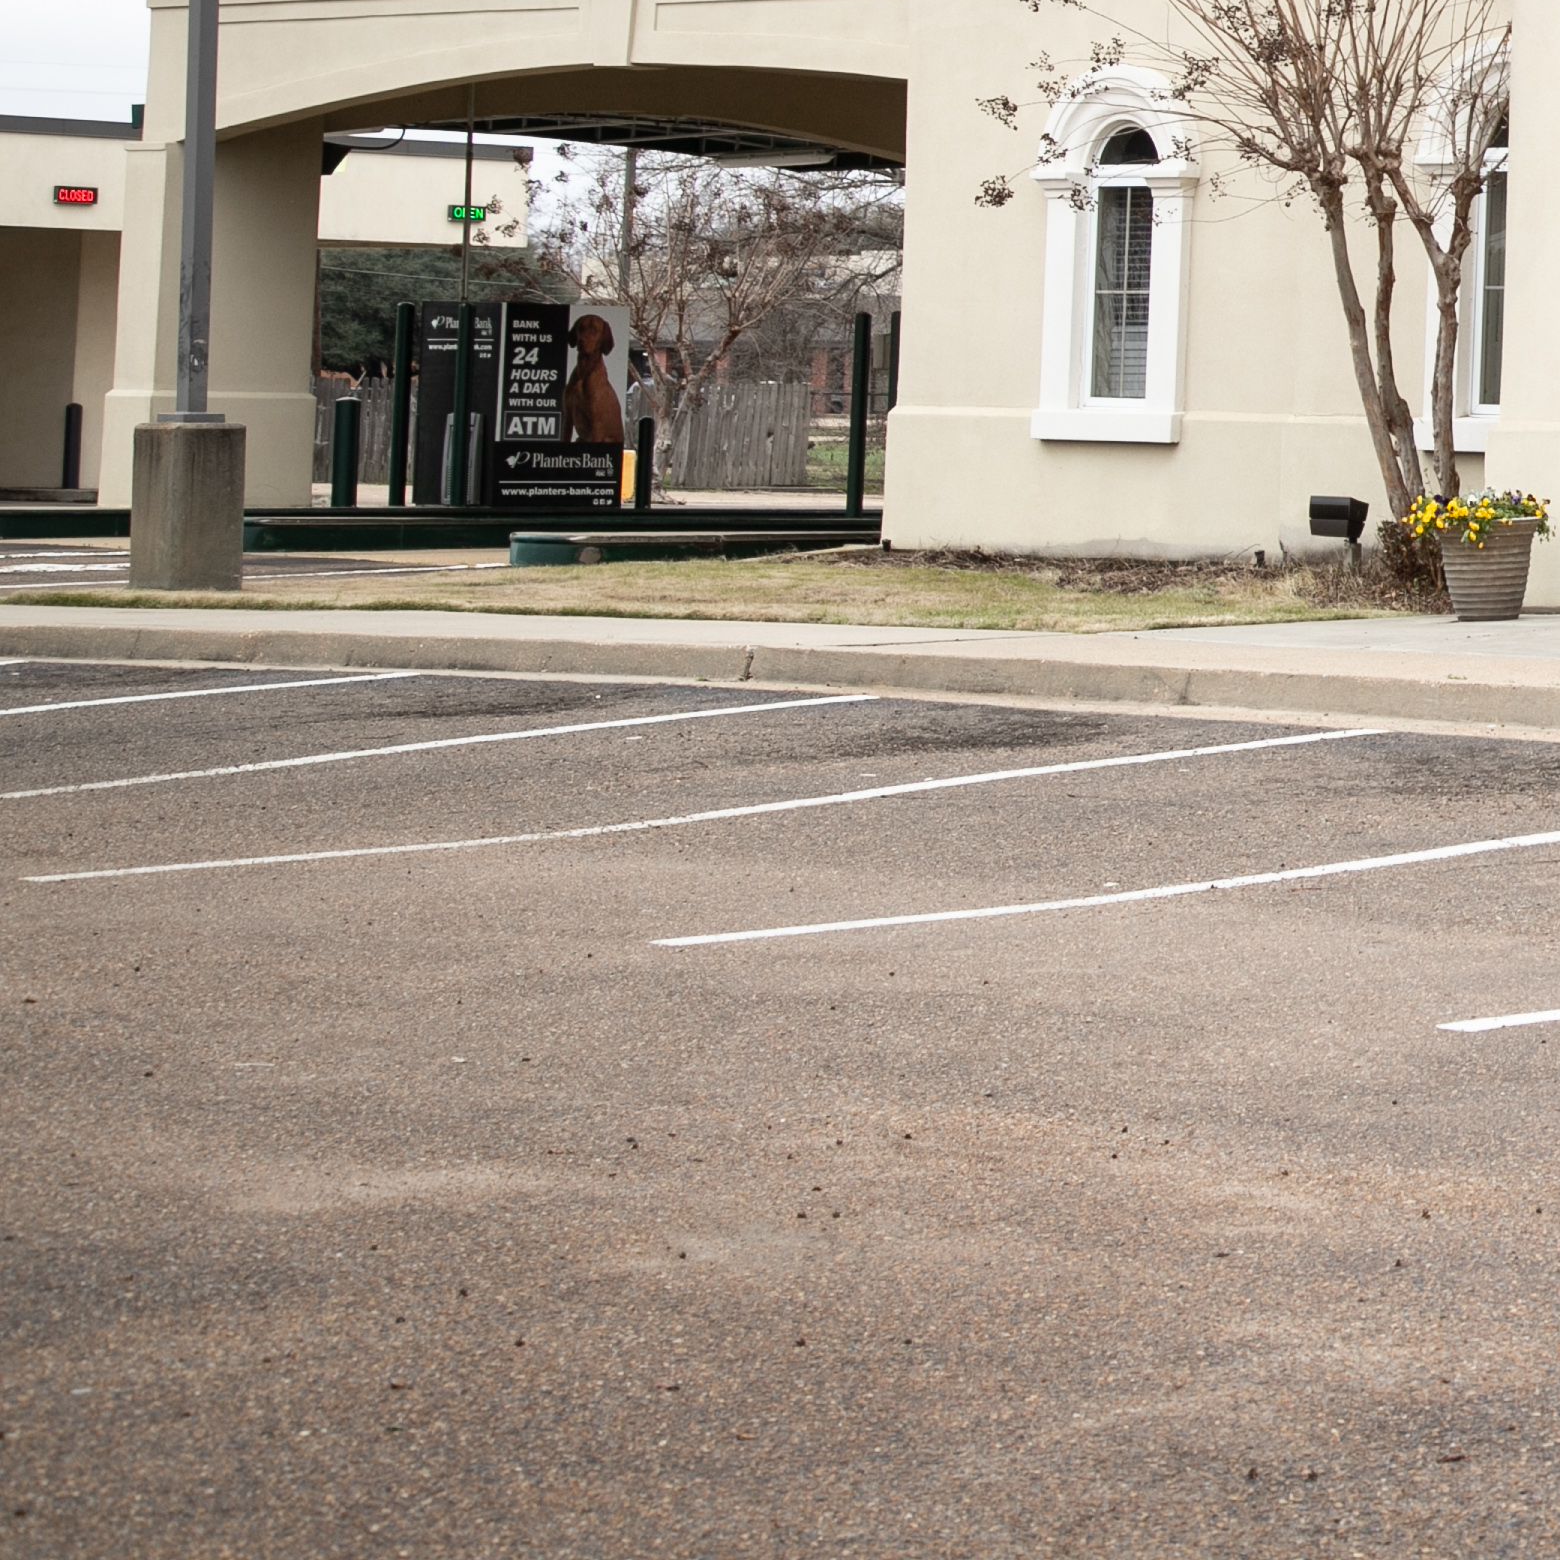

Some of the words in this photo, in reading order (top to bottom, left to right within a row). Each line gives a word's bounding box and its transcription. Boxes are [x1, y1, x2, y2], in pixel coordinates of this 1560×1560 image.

[59, 189, 93, 202] CLOSED
[512, 320, 540, 329] BANK
[512, 333, 537, 342] WITH
[539, 334, 553, 343] US
[512, 346, 540, 365] 24
[510, 368, 559, 381] HOURS
[509, 382, 520, 393] A
[522, 382, 550, 394] DAY
[509, 398, 534, 407] WITH
[536, 398, 557, 408] OUR
[507, 416, 556, 435] ATM
[501, 486, 614, 498] www.planters-bank.com
